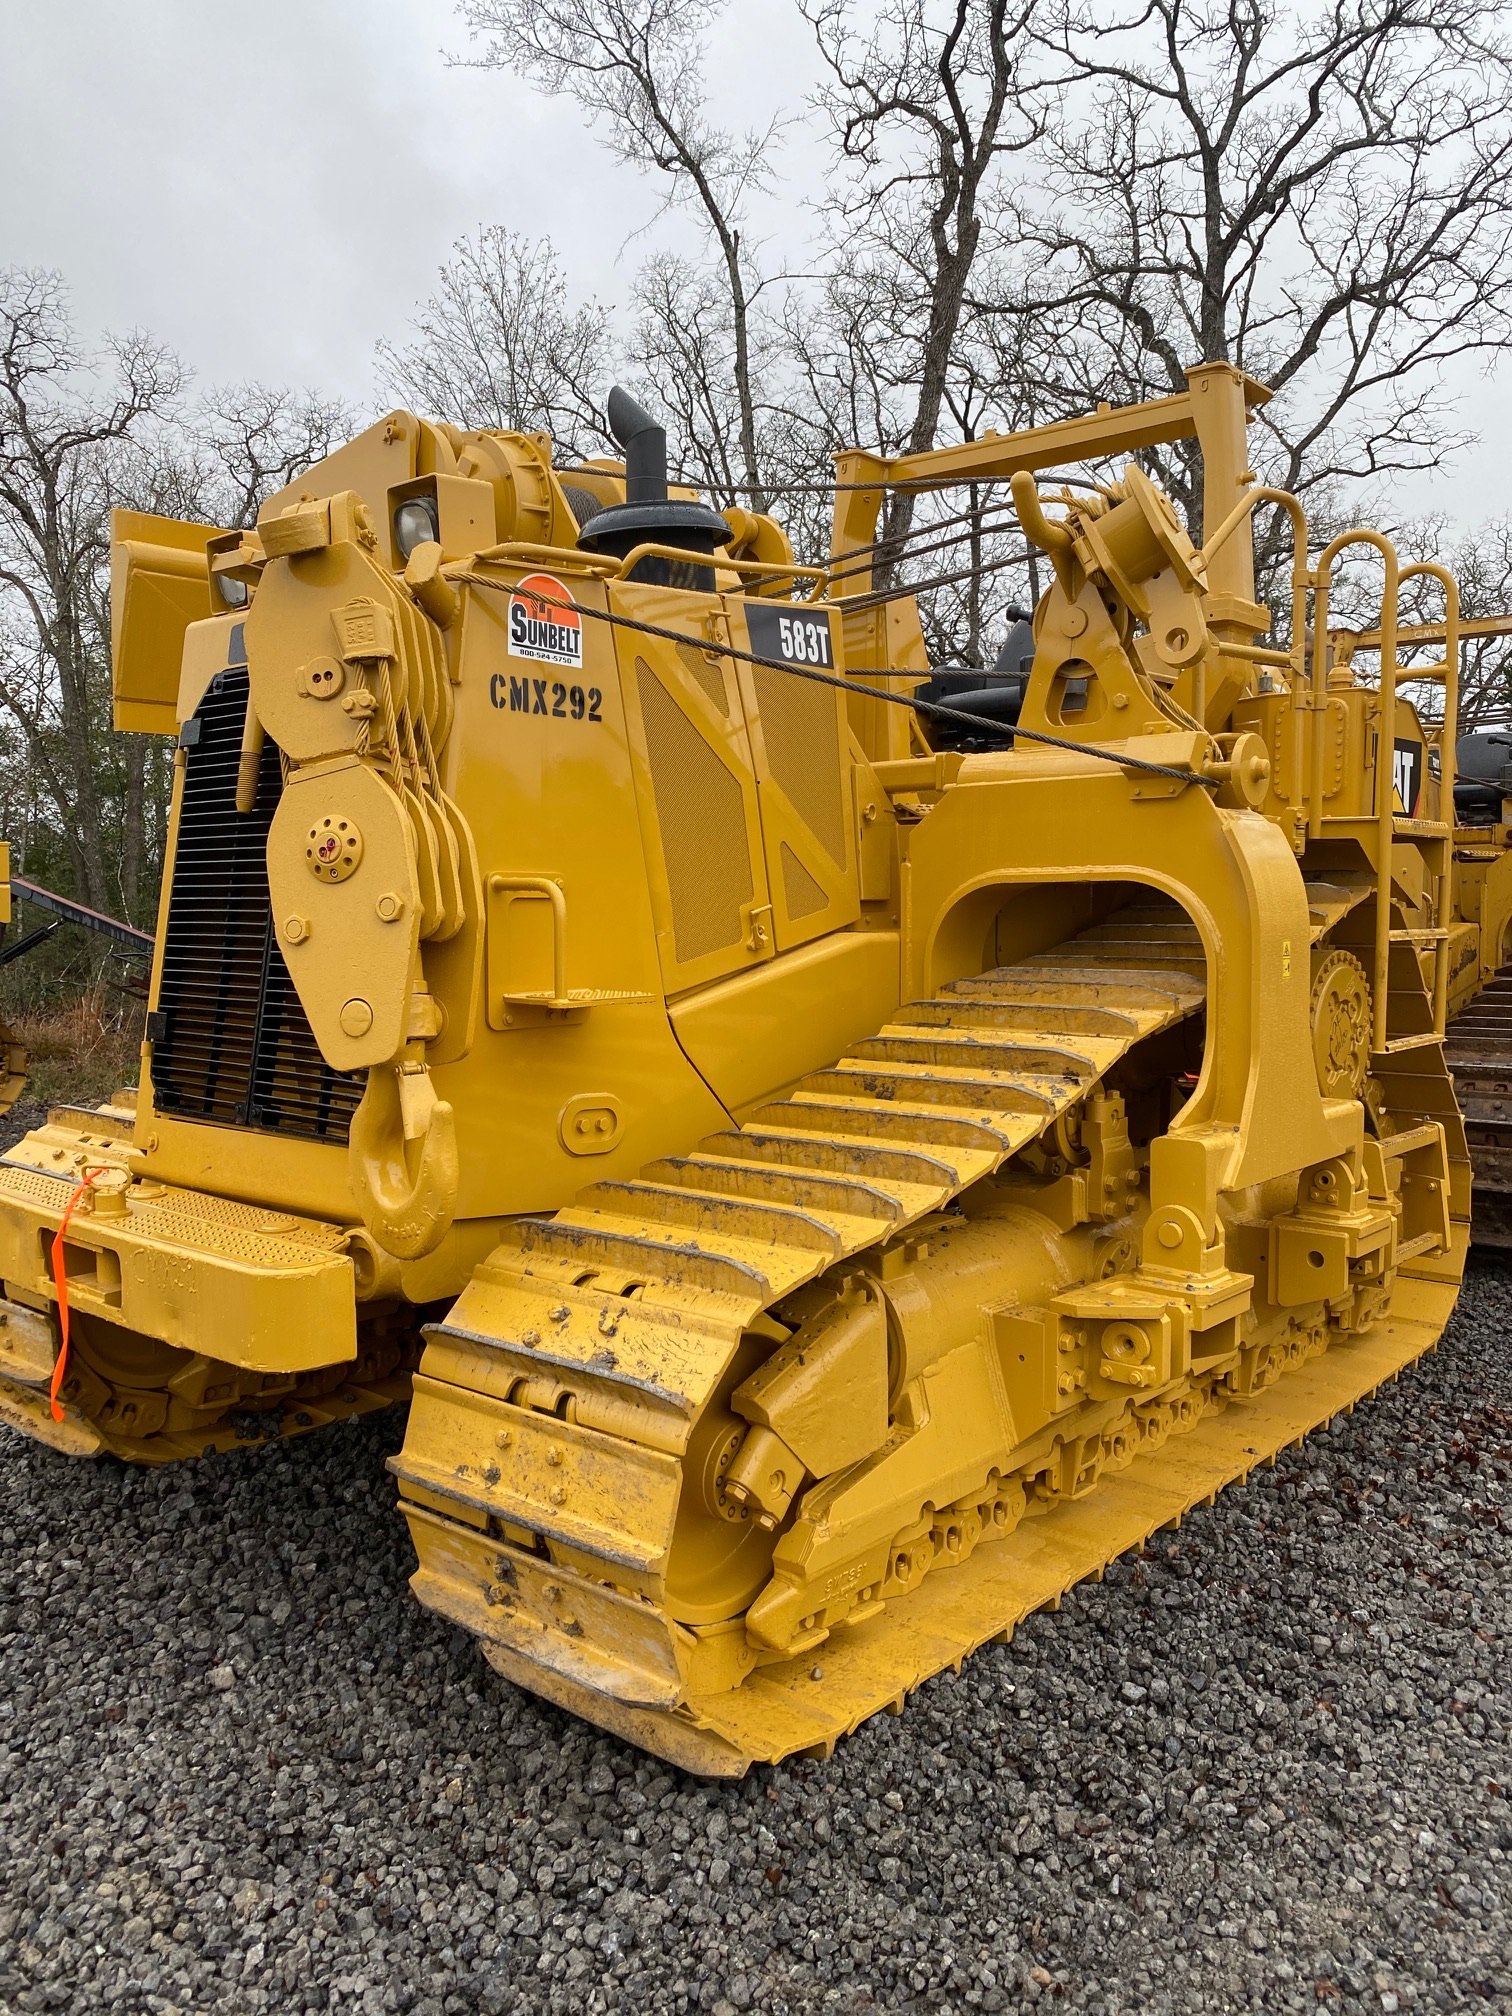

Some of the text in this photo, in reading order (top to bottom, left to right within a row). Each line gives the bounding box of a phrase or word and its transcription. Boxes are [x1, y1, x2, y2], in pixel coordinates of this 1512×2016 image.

[511, 603, 580, 654] SUNBELT
[779, 617, 828, 664] 583T
[519, 648, 572, 664] 800-524-5750
[490, 673, 602, 722] CMX292
